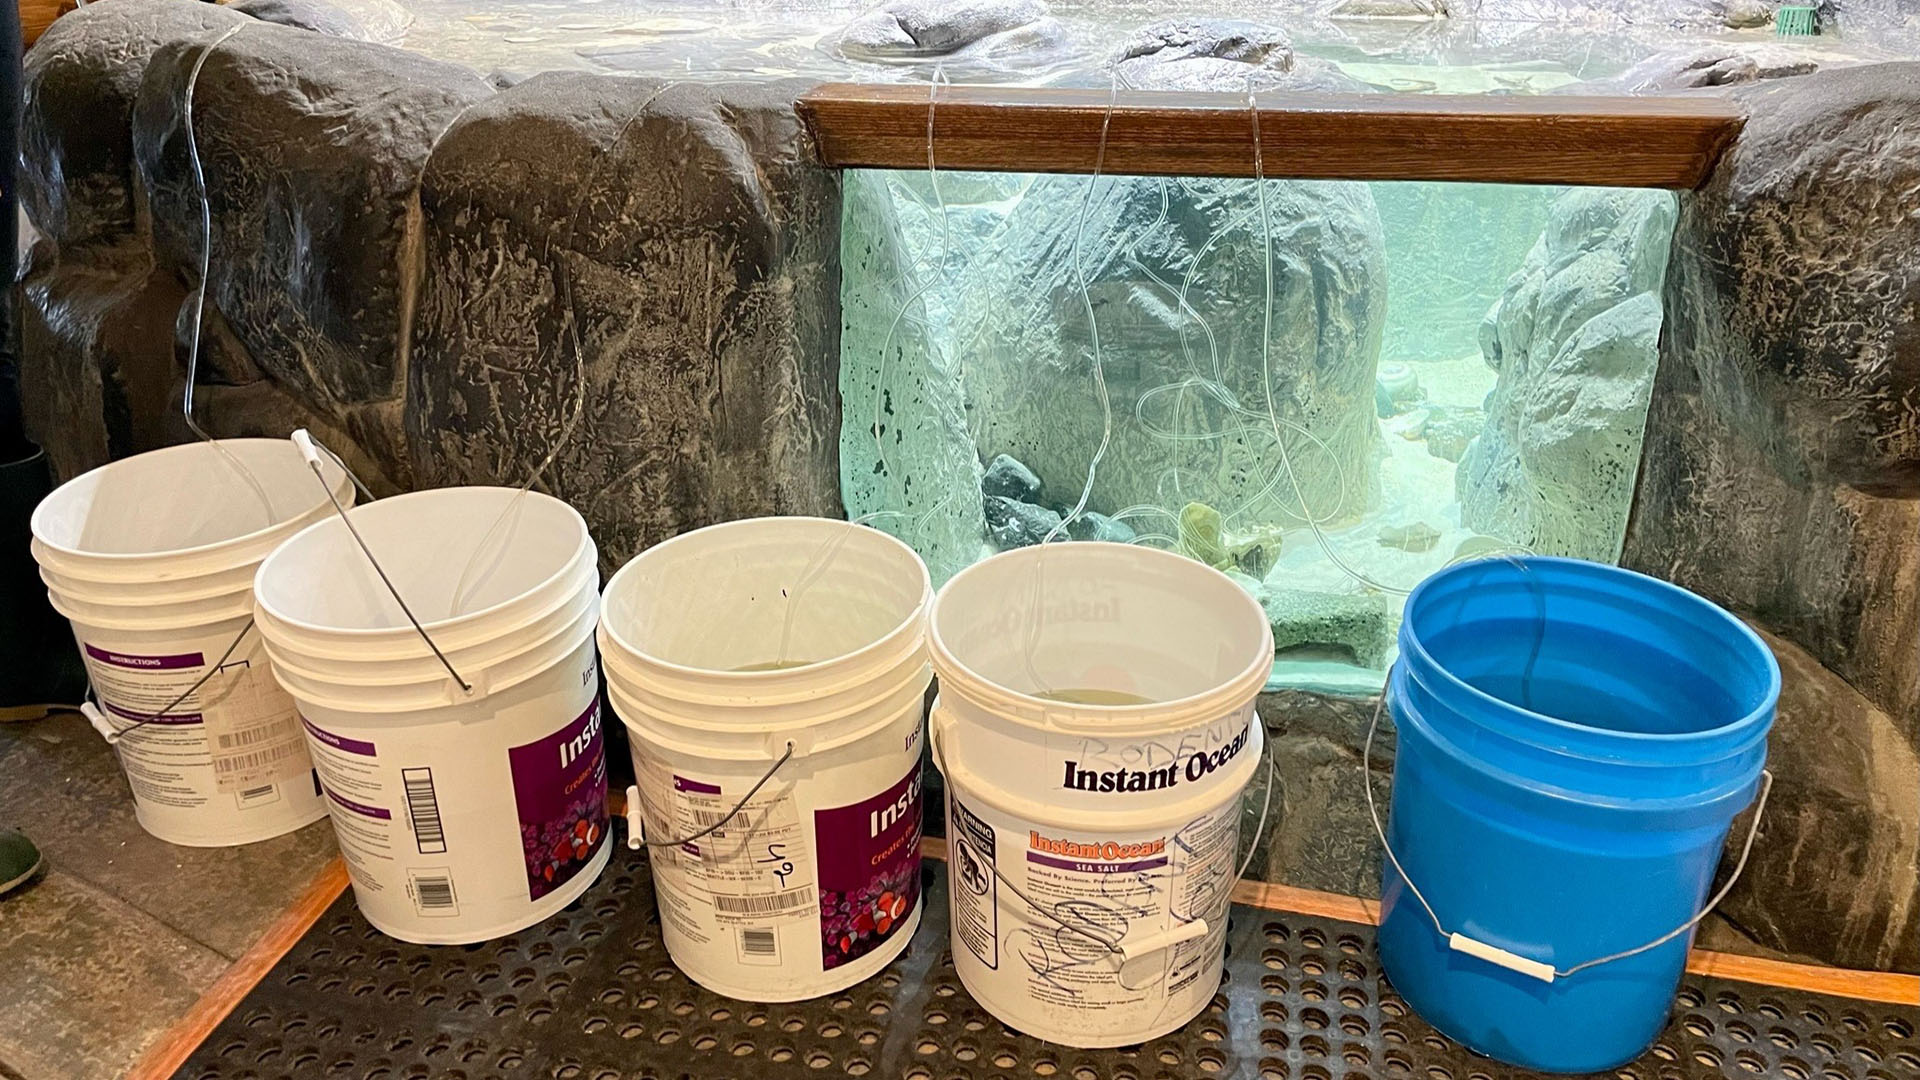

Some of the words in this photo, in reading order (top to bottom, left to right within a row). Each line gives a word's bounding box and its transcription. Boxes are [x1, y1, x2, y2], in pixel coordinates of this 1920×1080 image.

[1063, 760, 1178, 793] Instant
[1185, 723, 1249, 783] Ocean
[871, 836, 905, 865] Creates
[1029, 830, 1101, 860] Instant
[1101, 839, 1165, 861] Ocean
[1075, 863, 1094, 873] SEA
[1097, 864, 1120, 874] SALT
